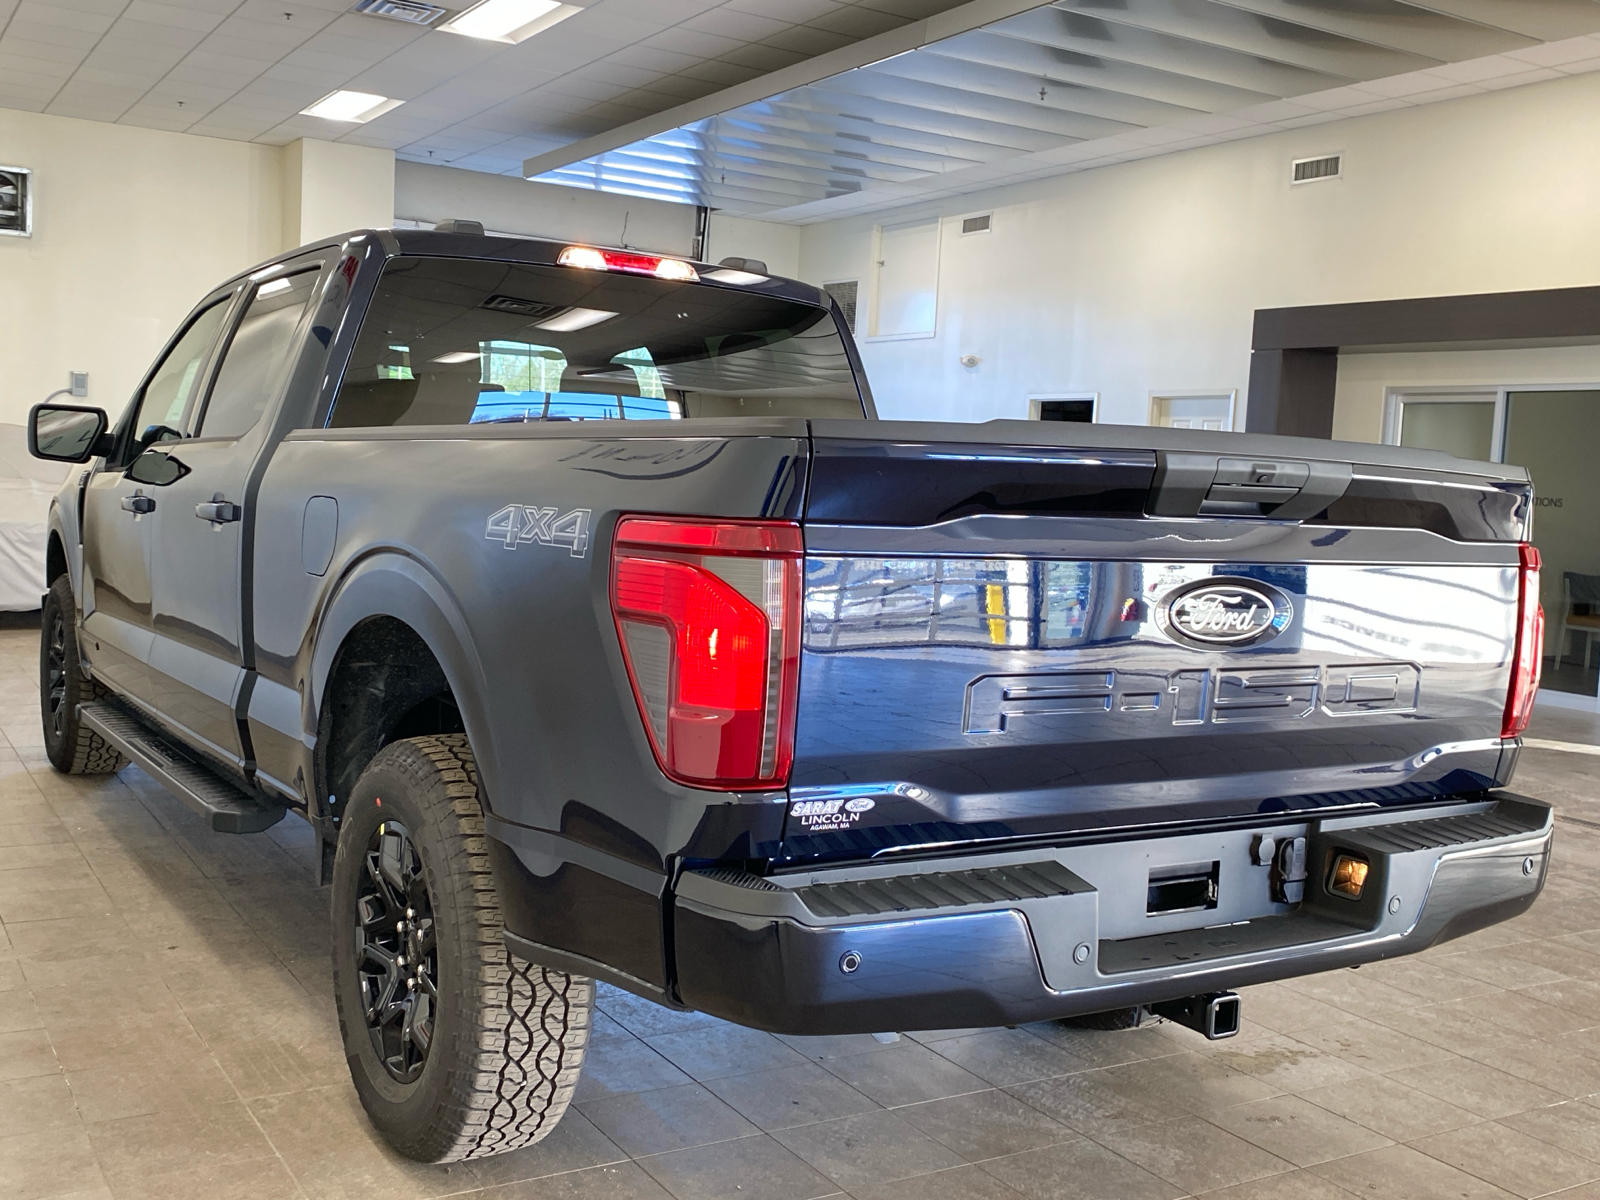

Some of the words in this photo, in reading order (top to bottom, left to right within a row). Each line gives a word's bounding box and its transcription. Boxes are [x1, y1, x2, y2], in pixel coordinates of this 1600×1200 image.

[1532, 496, 1563, 507] TIONS
[1190, 593, 1257, 631] Ford
[963, 661, 1423, 735] F-150
[791, 800, 844, 815] SARAT
[801, 813, 860, 825] LINCOLN
